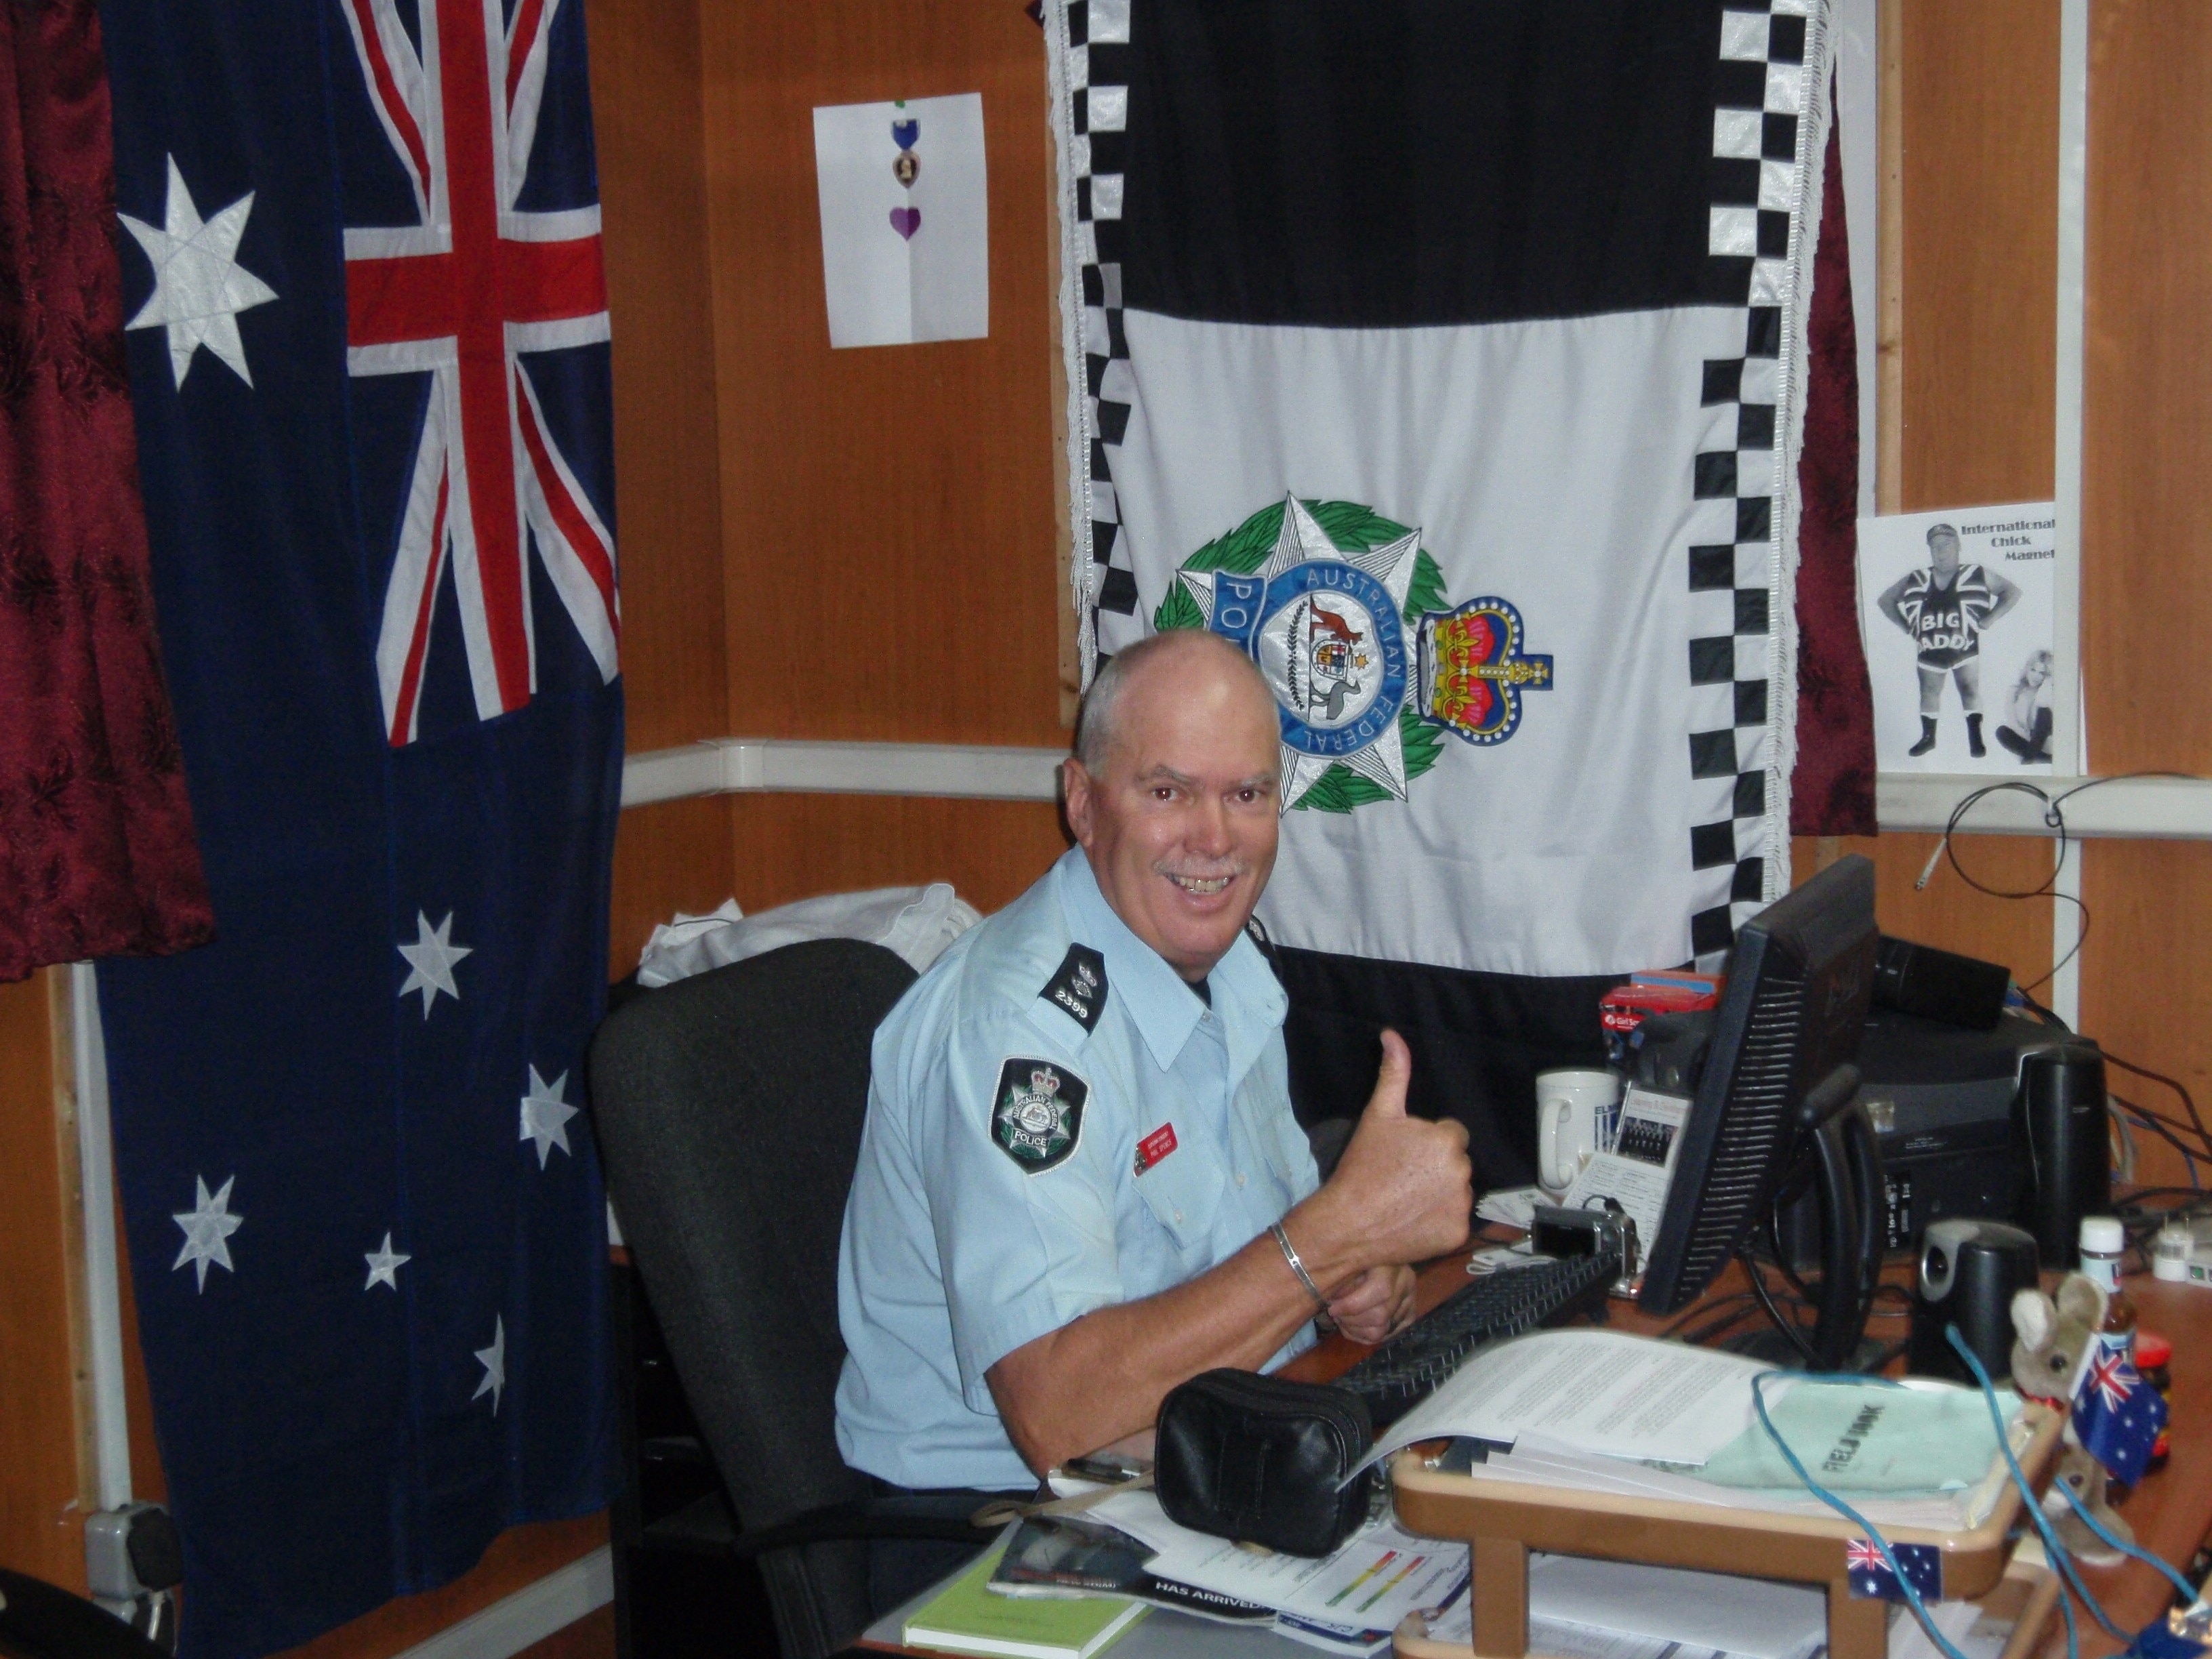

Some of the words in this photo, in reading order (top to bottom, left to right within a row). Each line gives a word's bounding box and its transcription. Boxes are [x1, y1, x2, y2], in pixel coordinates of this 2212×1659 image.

[1961, 519, 2055, 535] International
[1991, 536, 2031, 548] Chick
[2005, 549, 2055, 562] Magnet
[1307, 569, 1401, 678] AUSTRALIAN
[1921, 612, 1960, 631] BIG
[1305, 695, 1393, 751] FEDERAL
[1055, 989, 1088, 1019] 2399
[1013, 1094, 1046, 1119] AUSTRALIAN
[1045, 1101, 1058, 1130] FEDERAL
[1015, 1130, 1047, 1147] POLICE
[1155, 1581, 1189, 1596] HAS
